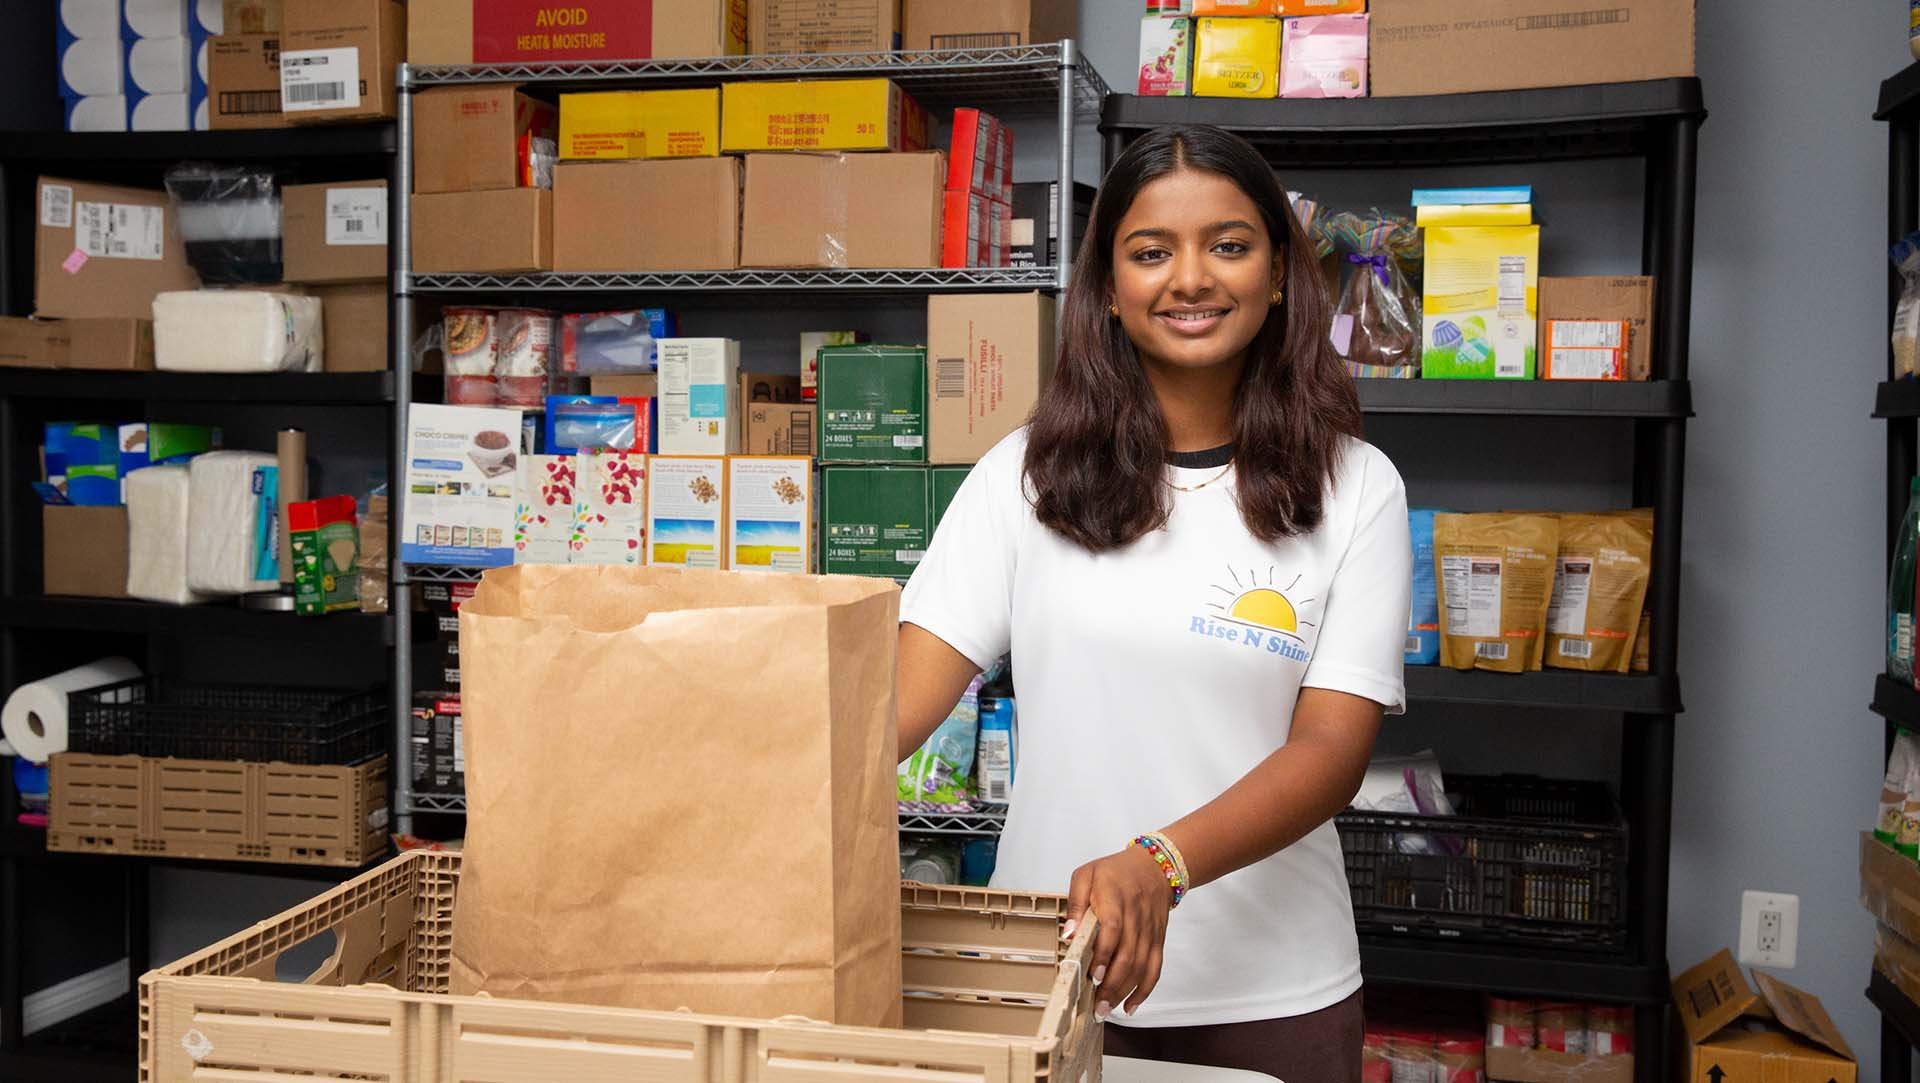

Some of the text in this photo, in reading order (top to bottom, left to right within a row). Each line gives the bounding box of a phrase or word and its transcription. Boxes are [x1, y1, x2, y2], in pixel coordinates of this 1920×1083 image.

[535, 8, 588, 27] AVOID
[1291, 21, 1299, 30] 12
[517, 32, 606, 50] HEAT& MOISTURE
[1217, 70, 1260, 79] SELTZER
[1228, 81, 1247, 89] LEMON
[979, 339, 988, 373] FUSILLI
[825, 434, 853, 443] 24 BOXES
[829, 548, 856, 557] 24 BOXES
[1189, 615, 1310, 663] Rise N Shine
